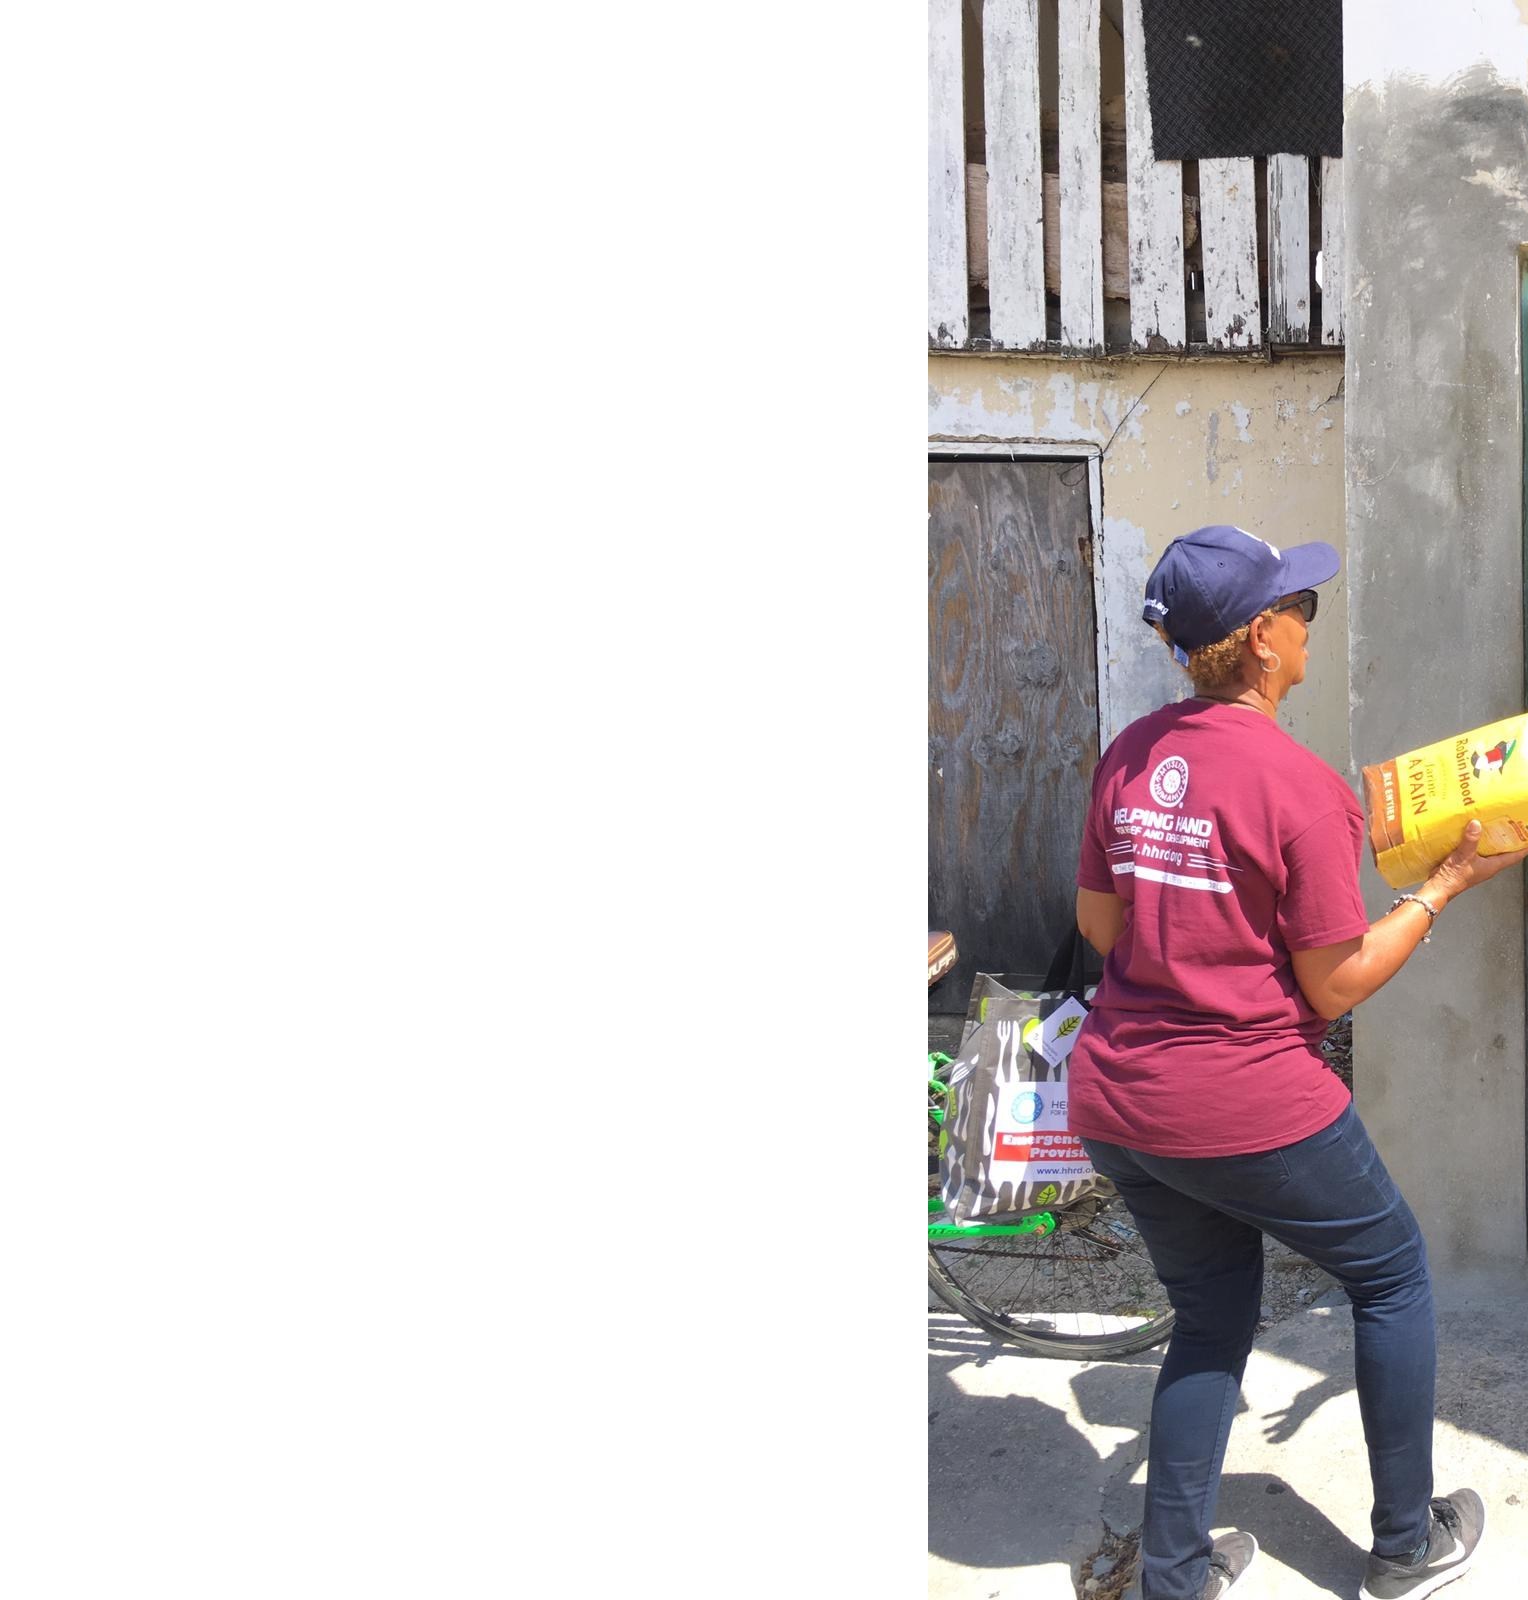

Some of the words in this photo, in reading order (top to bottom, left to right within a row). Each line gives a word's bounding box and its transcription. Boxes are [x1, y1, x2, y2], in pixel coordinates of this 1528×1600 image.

[1409, 759, 1423, 770] A
[1456, 738, 1469, 774] Robin
[1409, 771, 1428, 815] PAIN
[1458, 772, 1475, 806] Hood
[1114, 808, 1174, 831] HELPING
[1175, 816, 1213, 838] HAND
[1142, 829, 1164, 841] AND
[1002, 1134, 1081, 1147] Emergenc
[1037, 1166, 1096, 1175] www.hhrd.or
